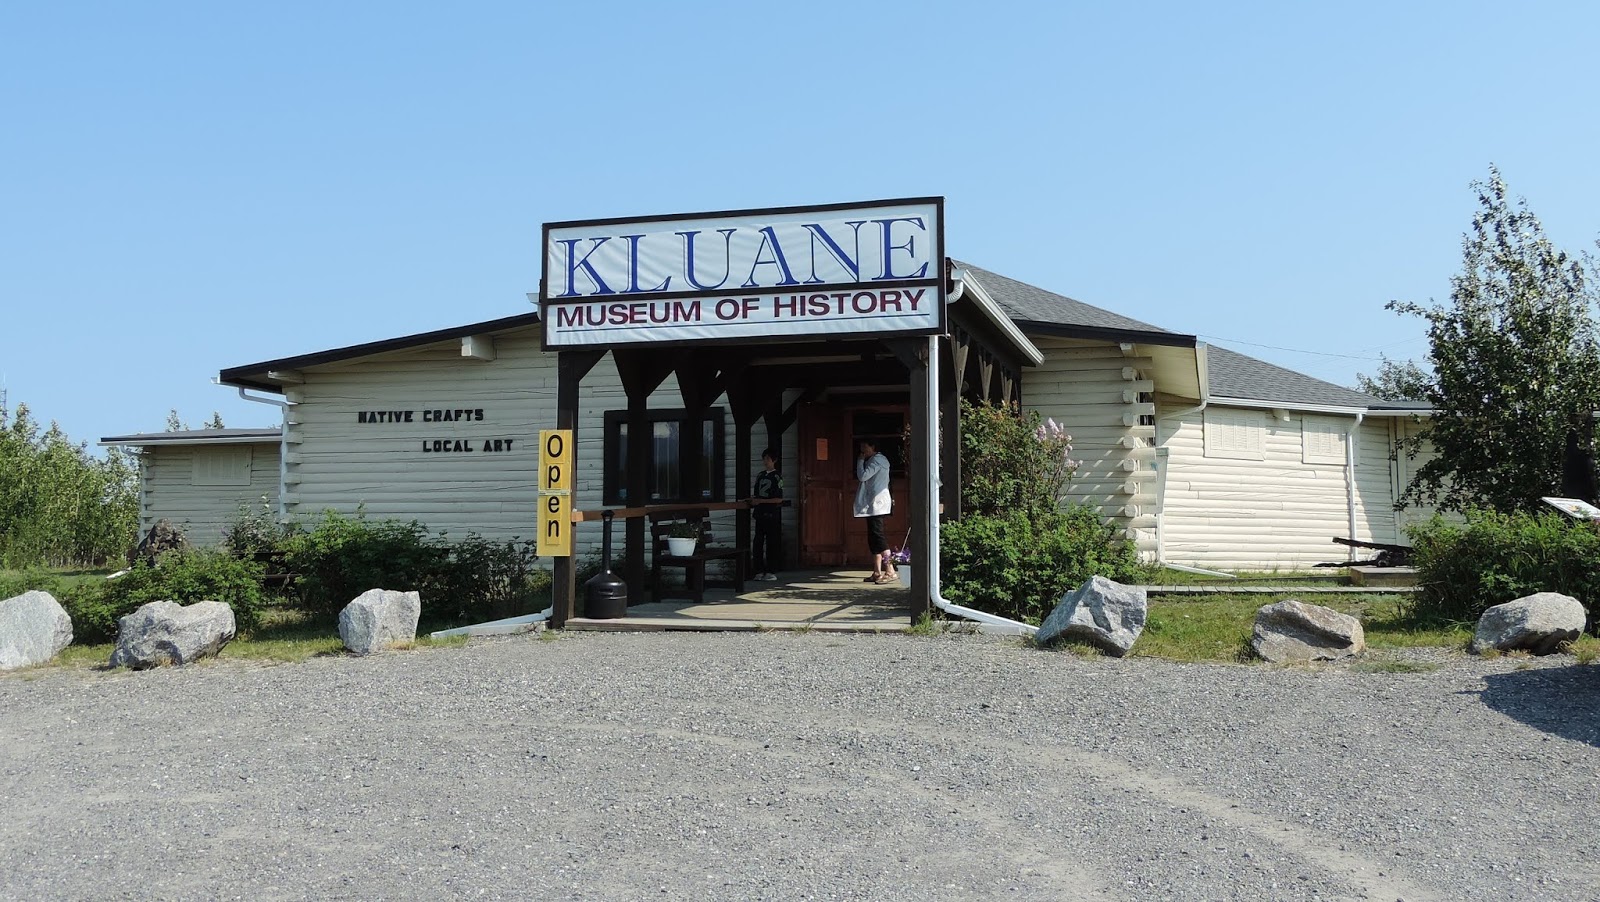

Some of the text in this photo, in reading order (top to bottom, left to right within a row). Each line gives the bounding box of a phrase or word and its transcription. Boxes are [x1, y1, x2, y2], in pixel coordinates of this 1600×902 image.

[556, 217, 930, 298] KLUANE
[556, 288, 927, 328] MUSEUM OF HISTORY
[358, 408, 484, 423] NATIVE CRAFTS
[423, 439, 514, 453] LOCAL ART
[547, 434, 564, 538] Open
